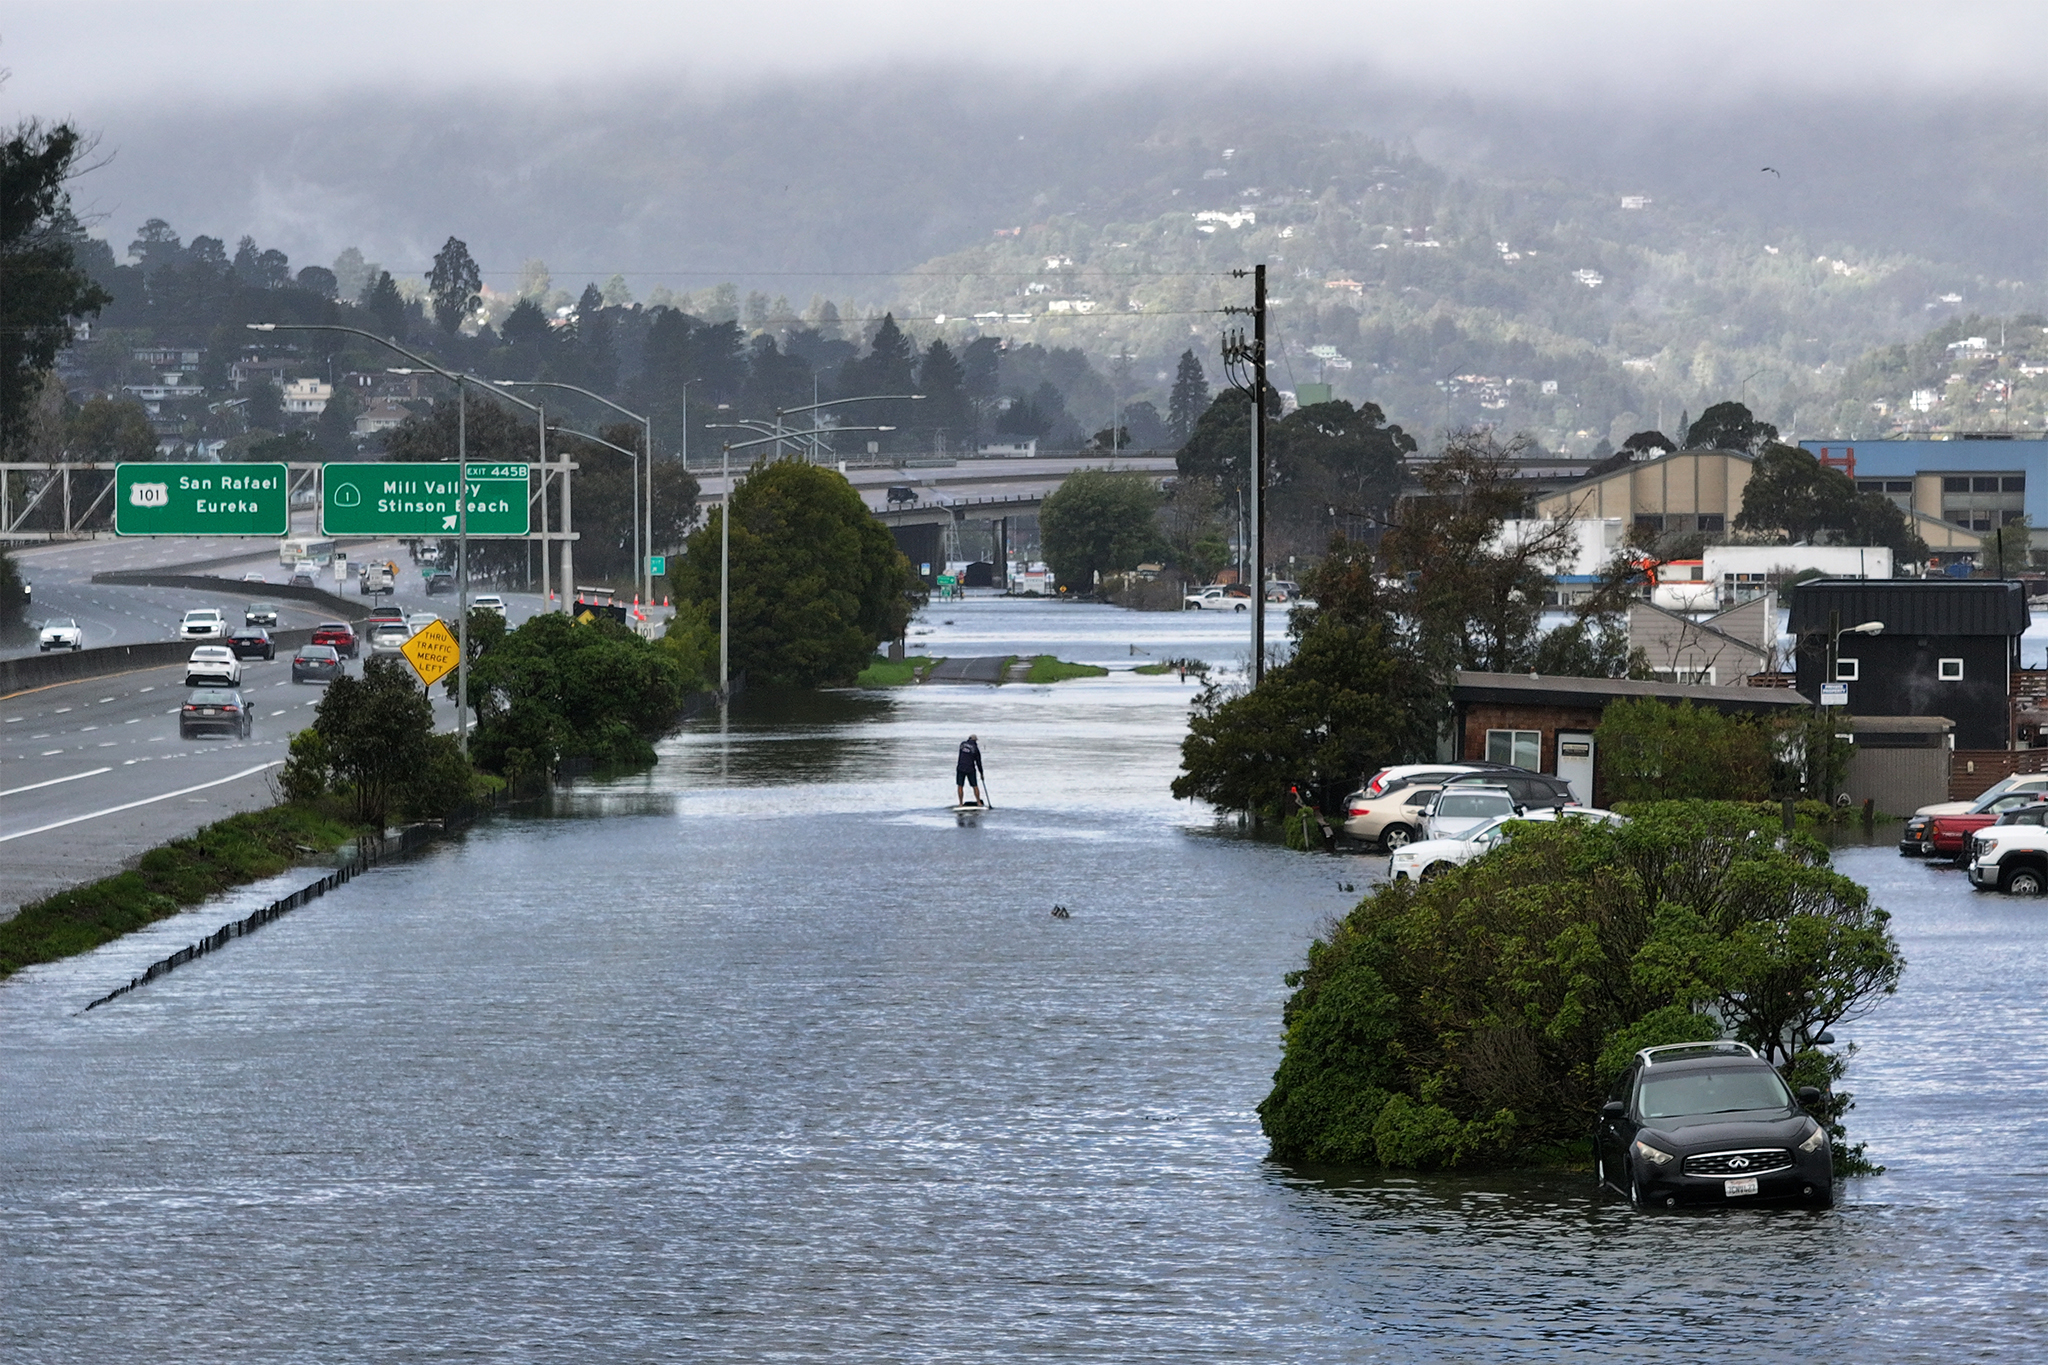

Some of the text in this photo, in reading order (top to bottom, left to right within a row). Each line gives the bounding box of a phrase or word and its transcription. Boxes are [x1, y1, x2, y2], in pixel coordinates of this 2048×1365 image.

[491, 467, 527, 476] 445B
[179, 476, 278, 490] San Rafael
[384, 481, 416, 494] Mill
[139, 490, 160, 502] 101
[346, 492, 350, 502] 1
[196, 500, 258, 513] Eureka
[378, 500, 446, 512] Stinson
[425, 632, 448, 642] THRU
[640, 628, 652, 638] 101
[416, 641, 452, 654] TRAFFIC
[417, 652, 448, 664] MERGE
[419, 663, 443, 672] LEFT
